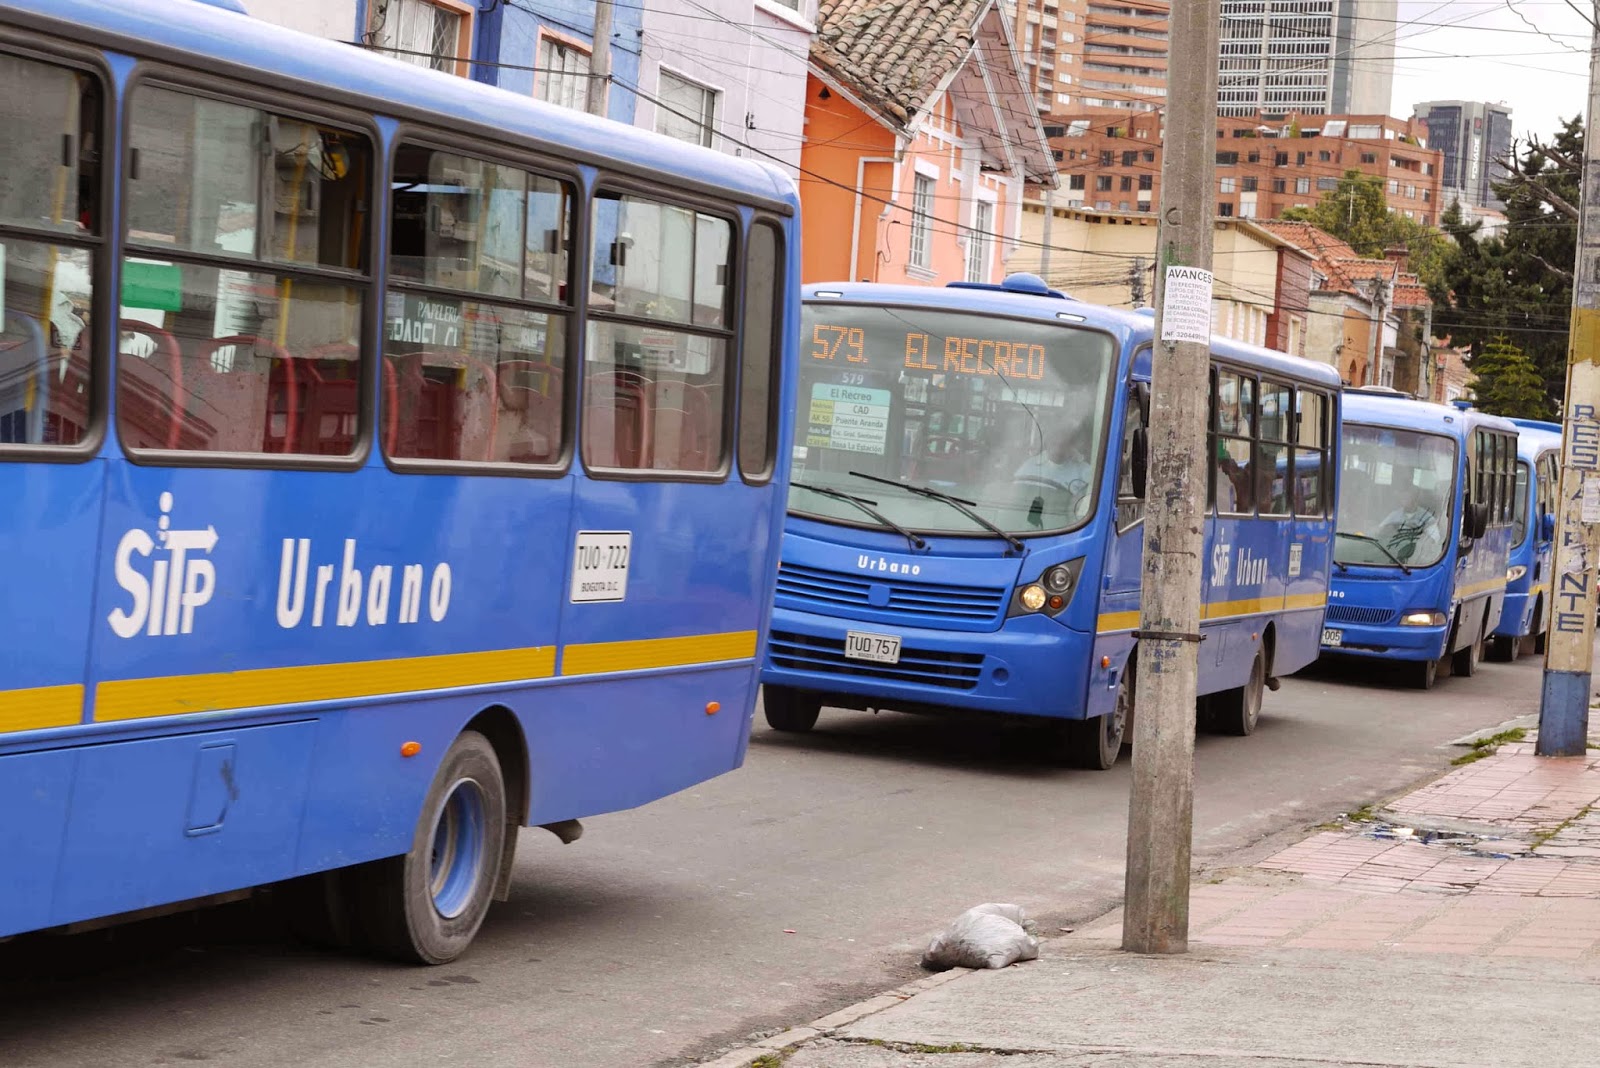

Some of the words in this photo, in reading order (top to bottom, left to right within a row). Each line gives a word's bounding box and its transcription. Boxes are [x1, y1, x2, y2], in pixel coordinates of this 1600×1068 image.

[1168, 268, 1212, 284] AVANCES
[904, 332, 937, 370] EL
[943, 336, 1045, 380] RECREO
[842, 372, 864, 385] 579
[830, 388, 840, 399] El
[841, 389, 872, 401] Recreo
[853, 405, 870, 415] CAD
[835, 416, 858, 426] Puente
[860, 417, 883, 428] Aranda
[848, 442, 857, 450] La
[857, 554, 921, 576] Urbano
[1236, 547, 1268, 587] Urbano
[276, 538, 452, 629] Urbano
